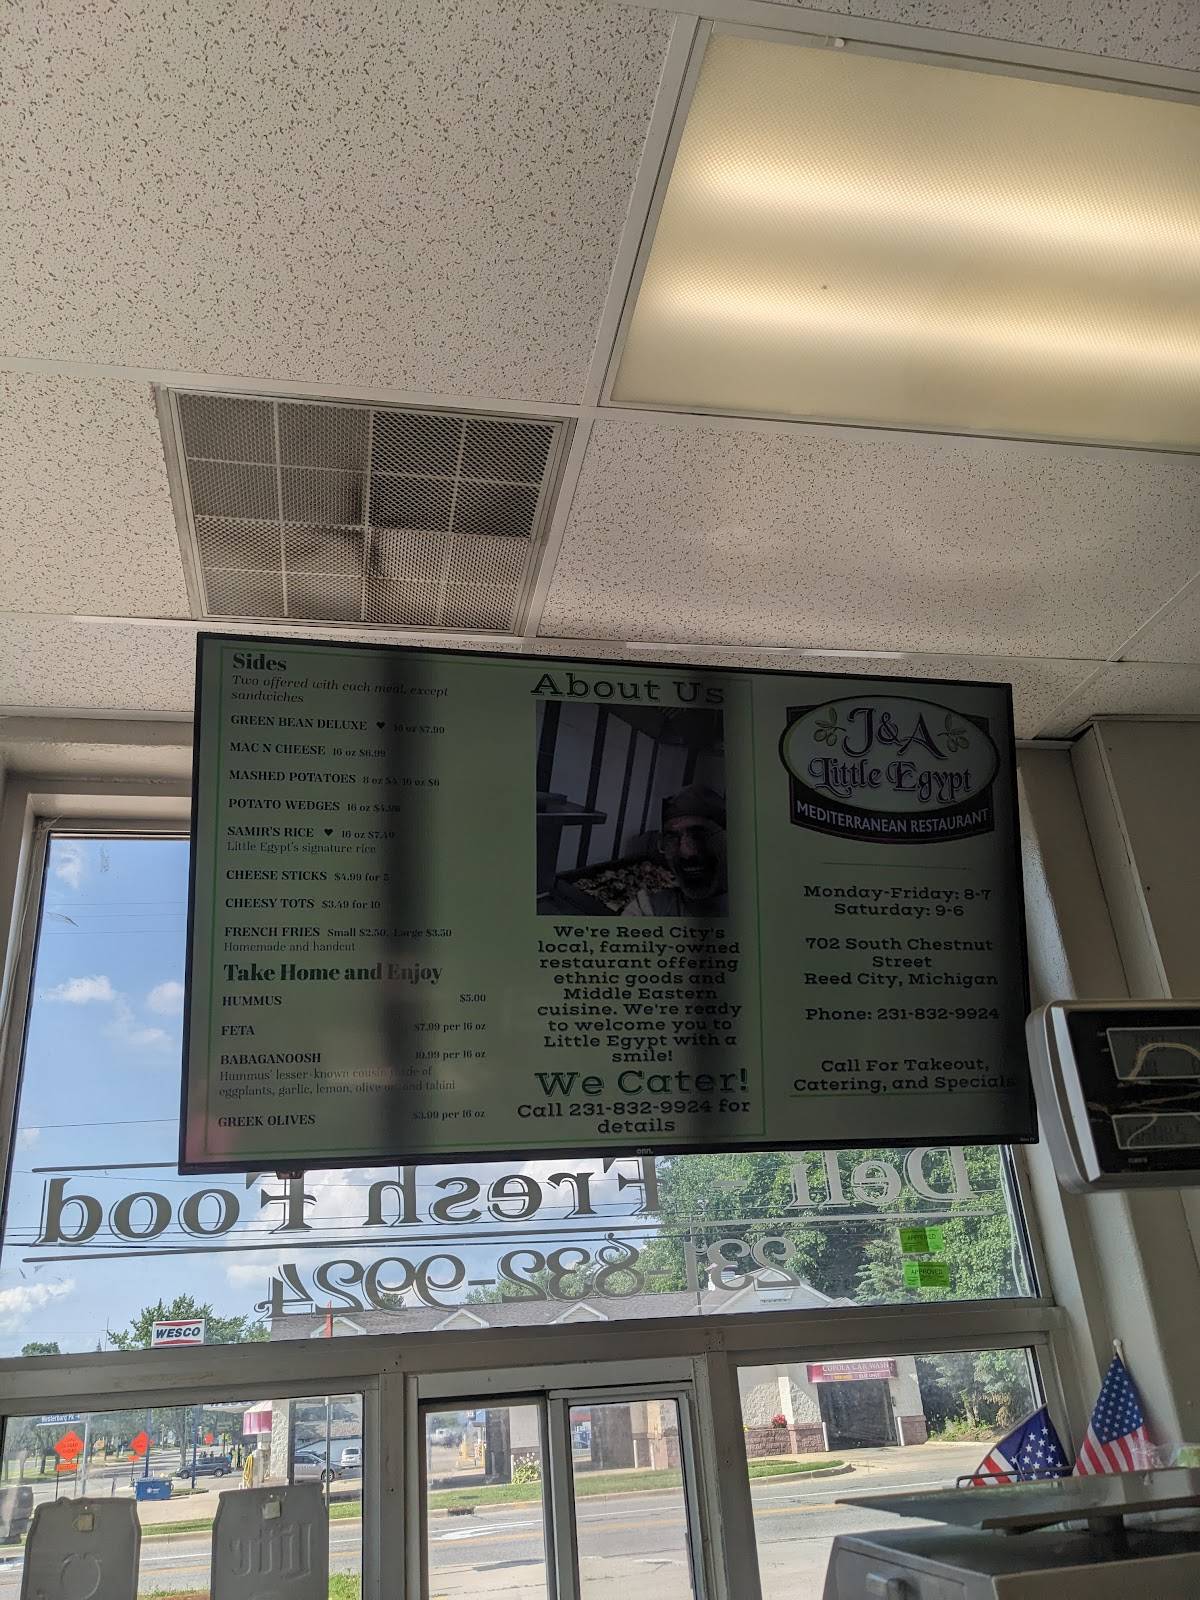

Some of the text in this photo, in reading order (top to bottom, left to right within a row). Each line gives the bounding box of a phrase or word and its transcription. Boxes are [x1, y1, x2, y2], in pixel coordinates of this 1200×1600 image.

[233, 652, 287, 671] Sides
[233, 675, 259, 686] Two
[263, 677, 308, 689] offered
[312, 679, 339, 691] with
[342, 681, 370, 692] each
[410, 687, 448, 699] except
[530, 672, 725, 703] About Us
[231, 690, 304, 703] sandwiches
[231, 714, 275, 726] GREEN
[279, 717, 314, 728] BEAN
[317, 719, 368, 731] DELUXE
[230, 742, 259, 753] MAC
[262, 743, 272, 753] N
[275, 744, 326, 756] CHEESE
[229, 769, 286, 781] MASHED
[289, 771, 357, 784] POTATOES
[371, 777, 383, 785] oz
[807, 757, 972, 805] Little Egypt
[228, 798, 281, 810] POTATO
[285, 799, 340, 811] WEDGES
[359, 804, 371, 812] oz
[796, 801, 989, 833] MEDITERRANEAN RESTAURANT
[227, 826, 281, 838] SAMIR'S
[284, 827, 314, 838] RICE
[354, 831, 366, 839] oz
[227, 840, 376, 855] Little Egypt's signature rice
[226, 869, 278, 880] CHEESE
[281, 870, 328, 881] STICKS
[365, 872, 380, 882] for
[803, 885, 992, 903] Monday-Friday: 8-7
[225, 898, 277, 909] CHEESY
[280, 898, 315, 909] TOTS
[352, 900, 368, 910] for
[370, 901, 381, 910] 10
[834, 903, 964, 919] Saturday: 9-6
[224, 927, 278, 938] FRENCH
[282, 927, 320, 938] FRIES
[327, 927, 356, 938] Small
[394, 928, 423, 940] Large
[553, 926, 725, 940] We're Reed City's
[224, 941, 356, 952] Homemade and handcut
[538, 941, 741, 957] local, family-owned
[805, 937, 993, 951] 702 South Chestnut
[539, 957, 739, 972] restaurant offering
[872, 955, 932, 968] Street
[224, 963, 443, 985] Take Home and Enjoy
[553, 972, 726, 987] ethnic goods and
[804, 972, 999, 988] Reed City, Michigan
[222, 995, 282, 1007] HUMMUS
[563, 987, 718, 1000] Middle Eastern
[537, 1002, 742, 1018] cuisine. We're ready
[805, 1007, 1000, 1021] Phone: 231-832-9924
[221, 1025, 255, 1037] FETA
[443, 1023, 461, 1033] per
[475, 1023, 486, 1031] oz
[548, 1018, 732, 1034] to welcome you to
[544, 1034, 737, 1050] Little Egypt with a
[220, 1053, 321, 1066] BABAGANOOSH
[443, 1051, 461, 1062] per
[475, 1050, 486, 1059] oz
[612, 1050, 673, 1063] smile!
[821, 1058, 990, 1072] Call For Takeout,
[220, 1069, 273, 1082] Hummus'
[276, 1068, 349, 1081] lesser-known
[534, 1067, 749, 1098] We Cater!
[219, 1086, 275, 1100] eggplants,
[278, 1084, 313, 1097] garlic,
[316, 1083, 352, 1096] lemon,
[794, 1075, 1017, 1094] Catering, and Specials
[517, 1098, 751, 1118] Call 231-832-9924 for
[218, 1115, 264, 1128] GREEK
[267, 1114, 316, 1126] OLIVES
[442, 1110, 460, 1122] per
[474, 1110, 485, 1118] oz
[597, 1118, 675, 1134] details
[156, 1327, 200, 1338] WESCO
[869, 1360, 889, 1370] WASH
